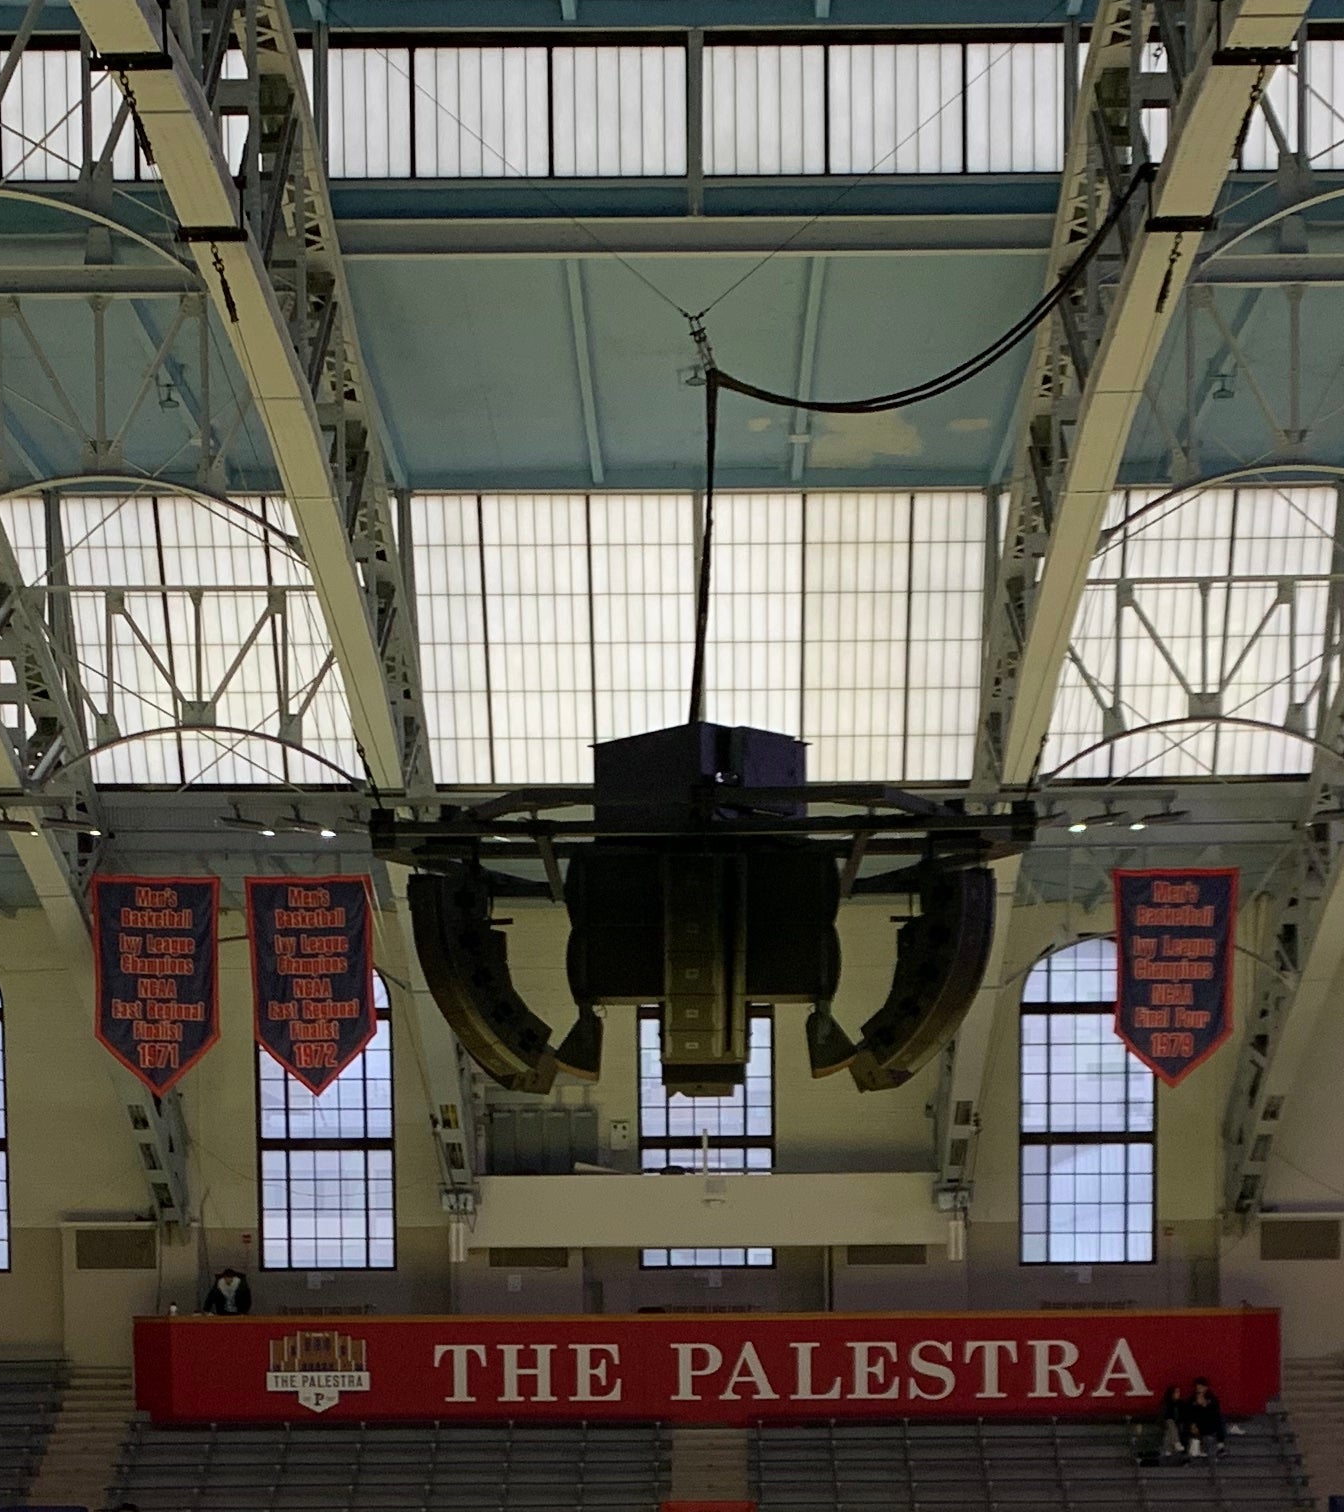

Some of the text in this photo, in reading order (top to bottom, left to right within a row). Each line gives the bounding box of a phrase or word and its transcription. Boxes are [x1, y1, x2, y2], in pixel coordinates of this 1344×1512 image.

[135, 888, 178, 907] Men's
[288, 887, 330, 907] Men's
[120, 908, 193, 929] Basketball
[275, 908, 346, 929] Basketball
[118, 934, 195, 955] Ivy League
[274, 934, 349, 956] Ivy League
[1161, 935, 1216, 959] League
[120, 955, 194, 977] Champions
[277, 955, 348, 977] Champions
[1134, 958, 1215, 982] Champions
[137, 979, 177, 998] NCAA
[293, 979, 333, 998] NCAA
[111, 1000, 204, 1021] East Regional
[267, 999, 360, 1020] East Regional
[133, 1022, 183, 1041] Finalist
[290, 1021, 340, 1040] Finalist
[1150, 1032, 1195, 1057] 1979
[139, 1044, 180, 1068] 1971
[293, 1043, 338, 1068] 1972
[433, 1338, 1154, 1402] THE PALESTRA
[273, 1375, 363, 1387] THE PALESTRA
[314, 1393, 325, 1406] P
